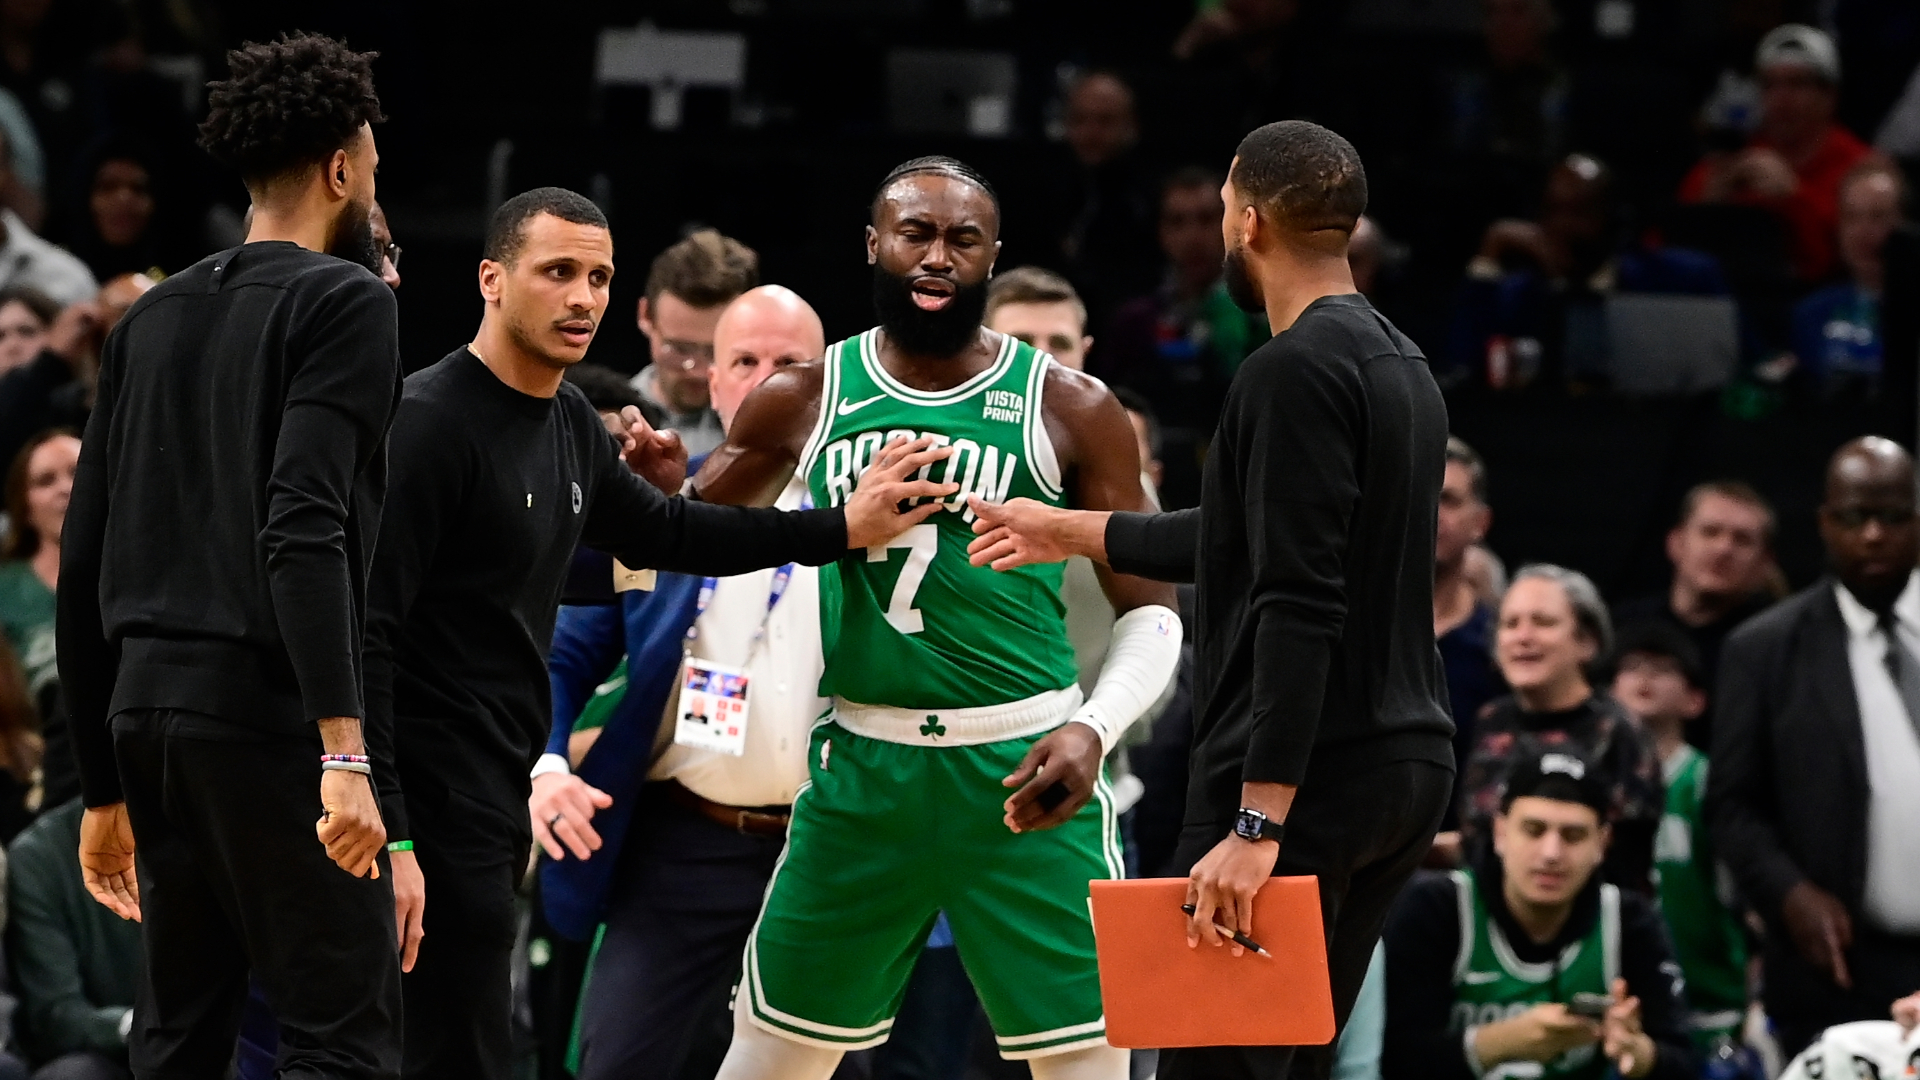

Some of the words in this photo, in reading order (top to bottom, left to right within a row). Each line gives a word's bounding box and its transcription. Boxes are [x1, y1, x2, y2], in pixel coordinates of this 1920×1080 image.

[985, 390, 1024, 412] VISTA
[983, 406, 1023, 424] PRINT
[866, 523, 938, 635] 7
